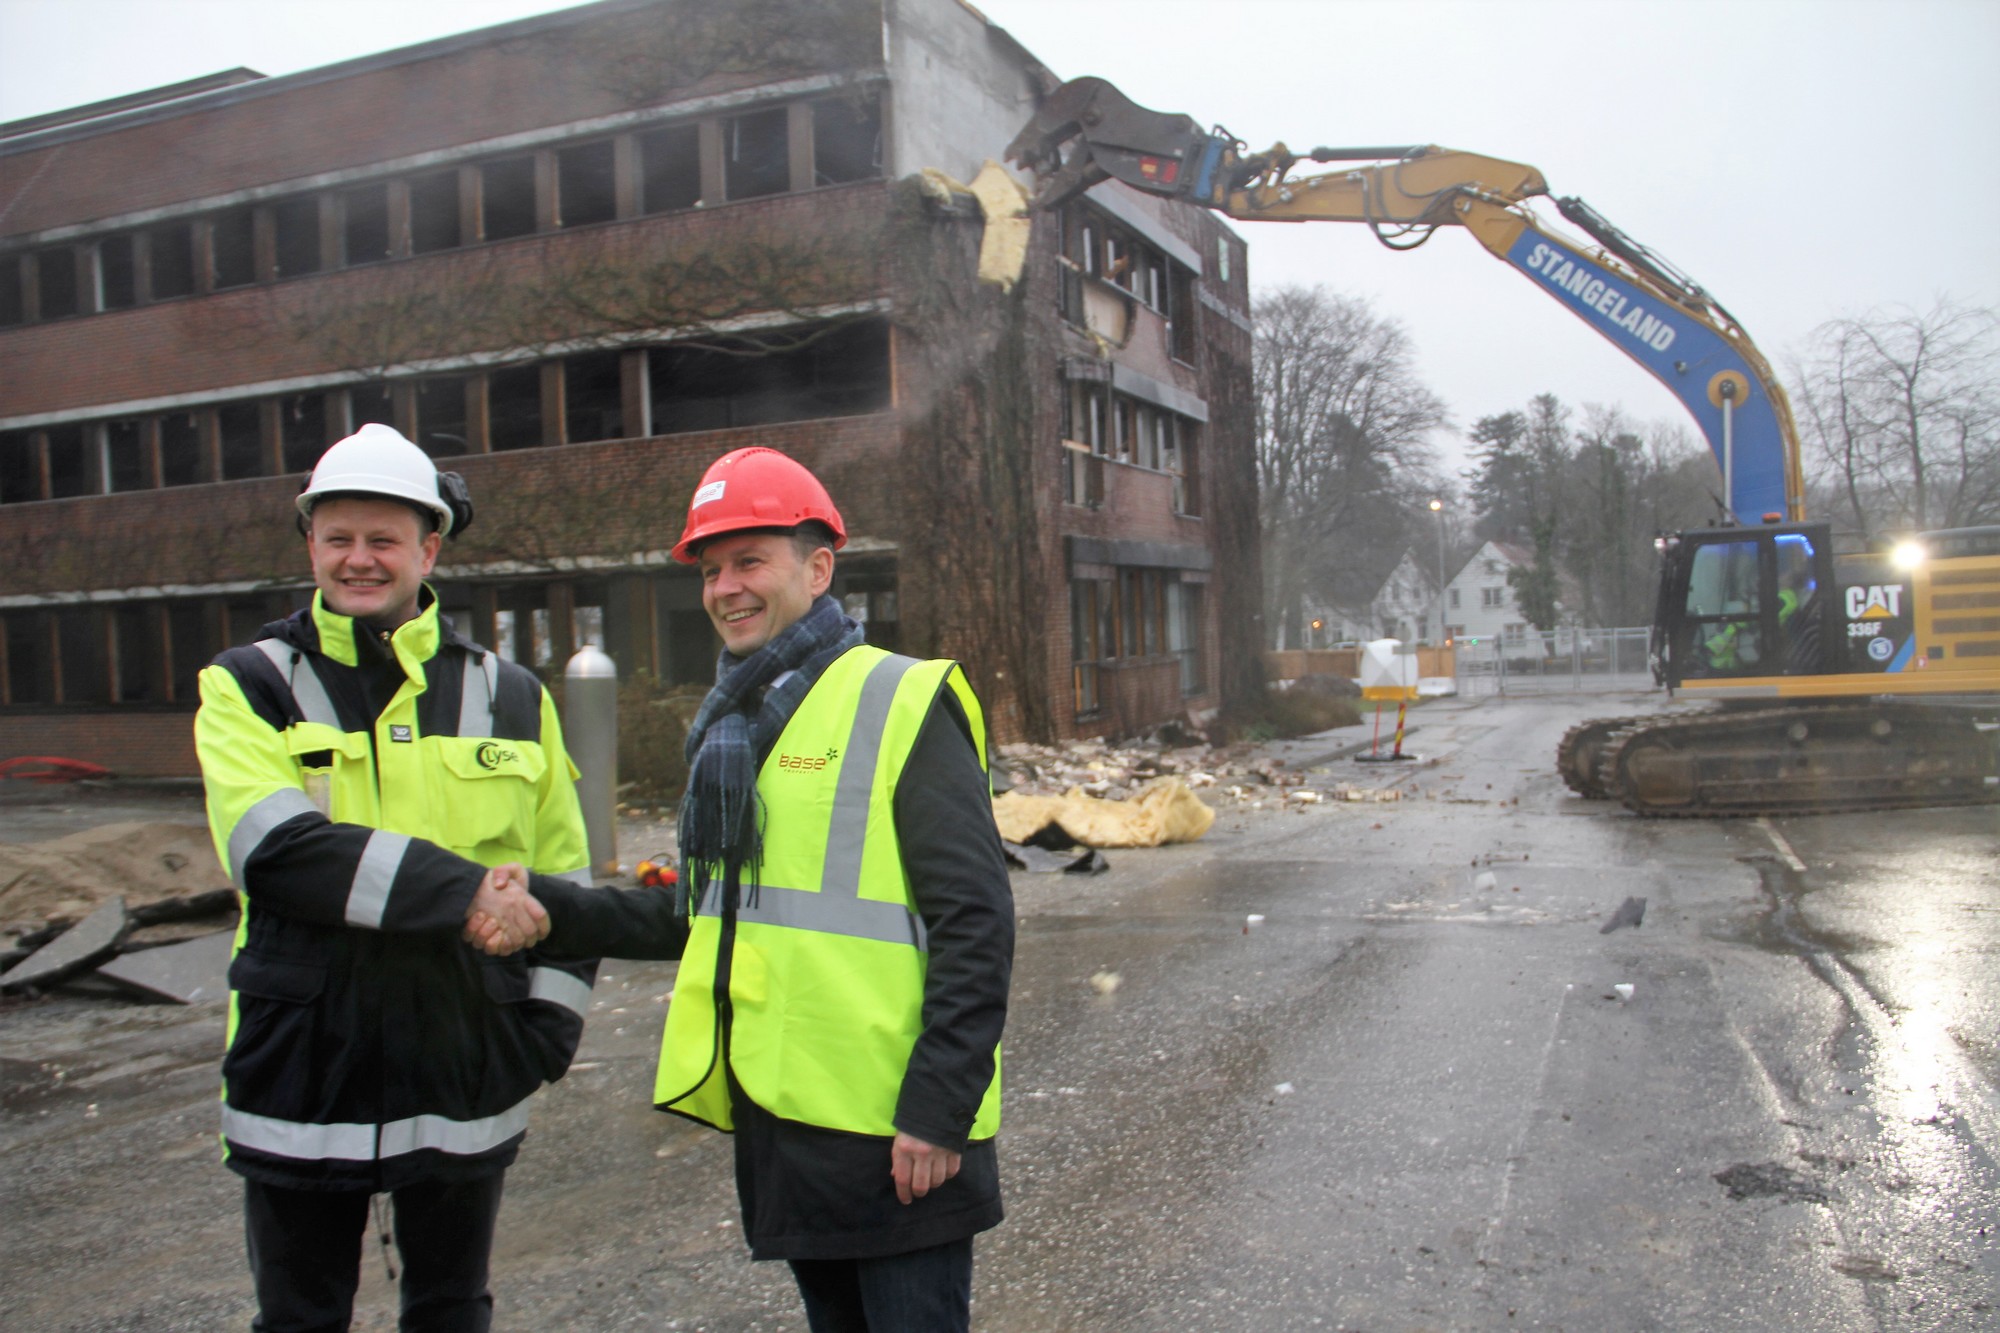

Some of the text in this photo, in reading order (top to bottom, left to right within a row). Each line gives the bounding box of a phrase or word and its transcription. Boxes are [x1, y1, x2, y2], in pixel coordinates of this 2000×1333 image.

[1527, 244, 1676, 351] STANGELAND
[1845, 584, 1903, 619] CAT
[1847, 621, 1882, 637] 336F
